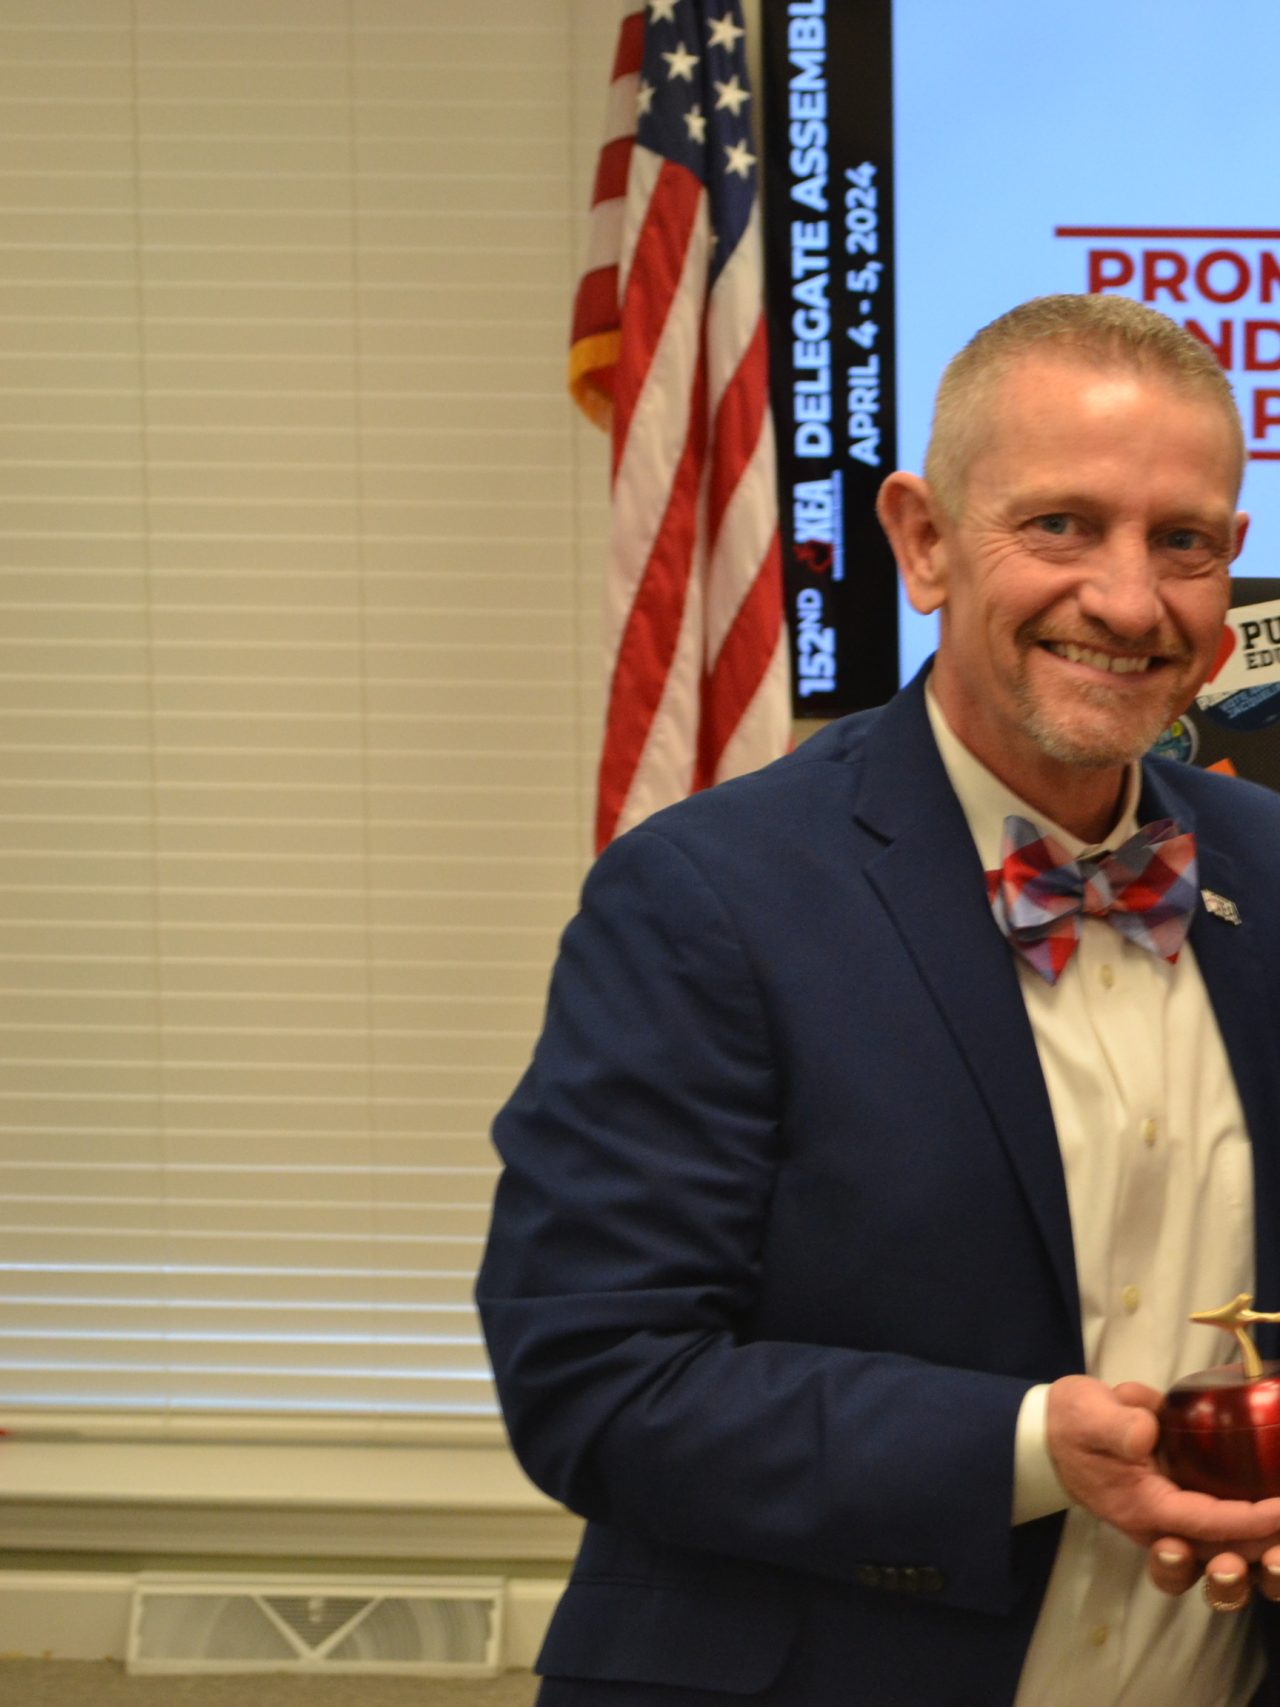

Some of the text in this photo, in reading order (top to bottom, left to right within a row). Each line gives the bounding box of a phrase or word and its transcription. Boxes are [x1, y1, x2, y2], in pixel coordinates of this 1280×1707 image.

[788, 0, 829, 212] ASSEMBL
[845, 161, 878, 255] 2024
[846, 261, 884, 293] 5,
[791, 220, 832, 458] DELEGATE
[846, 320, 879, 348] 4
[847, 354, 881, 466] APRIL
[796, 587, 837, 697] 152ND
